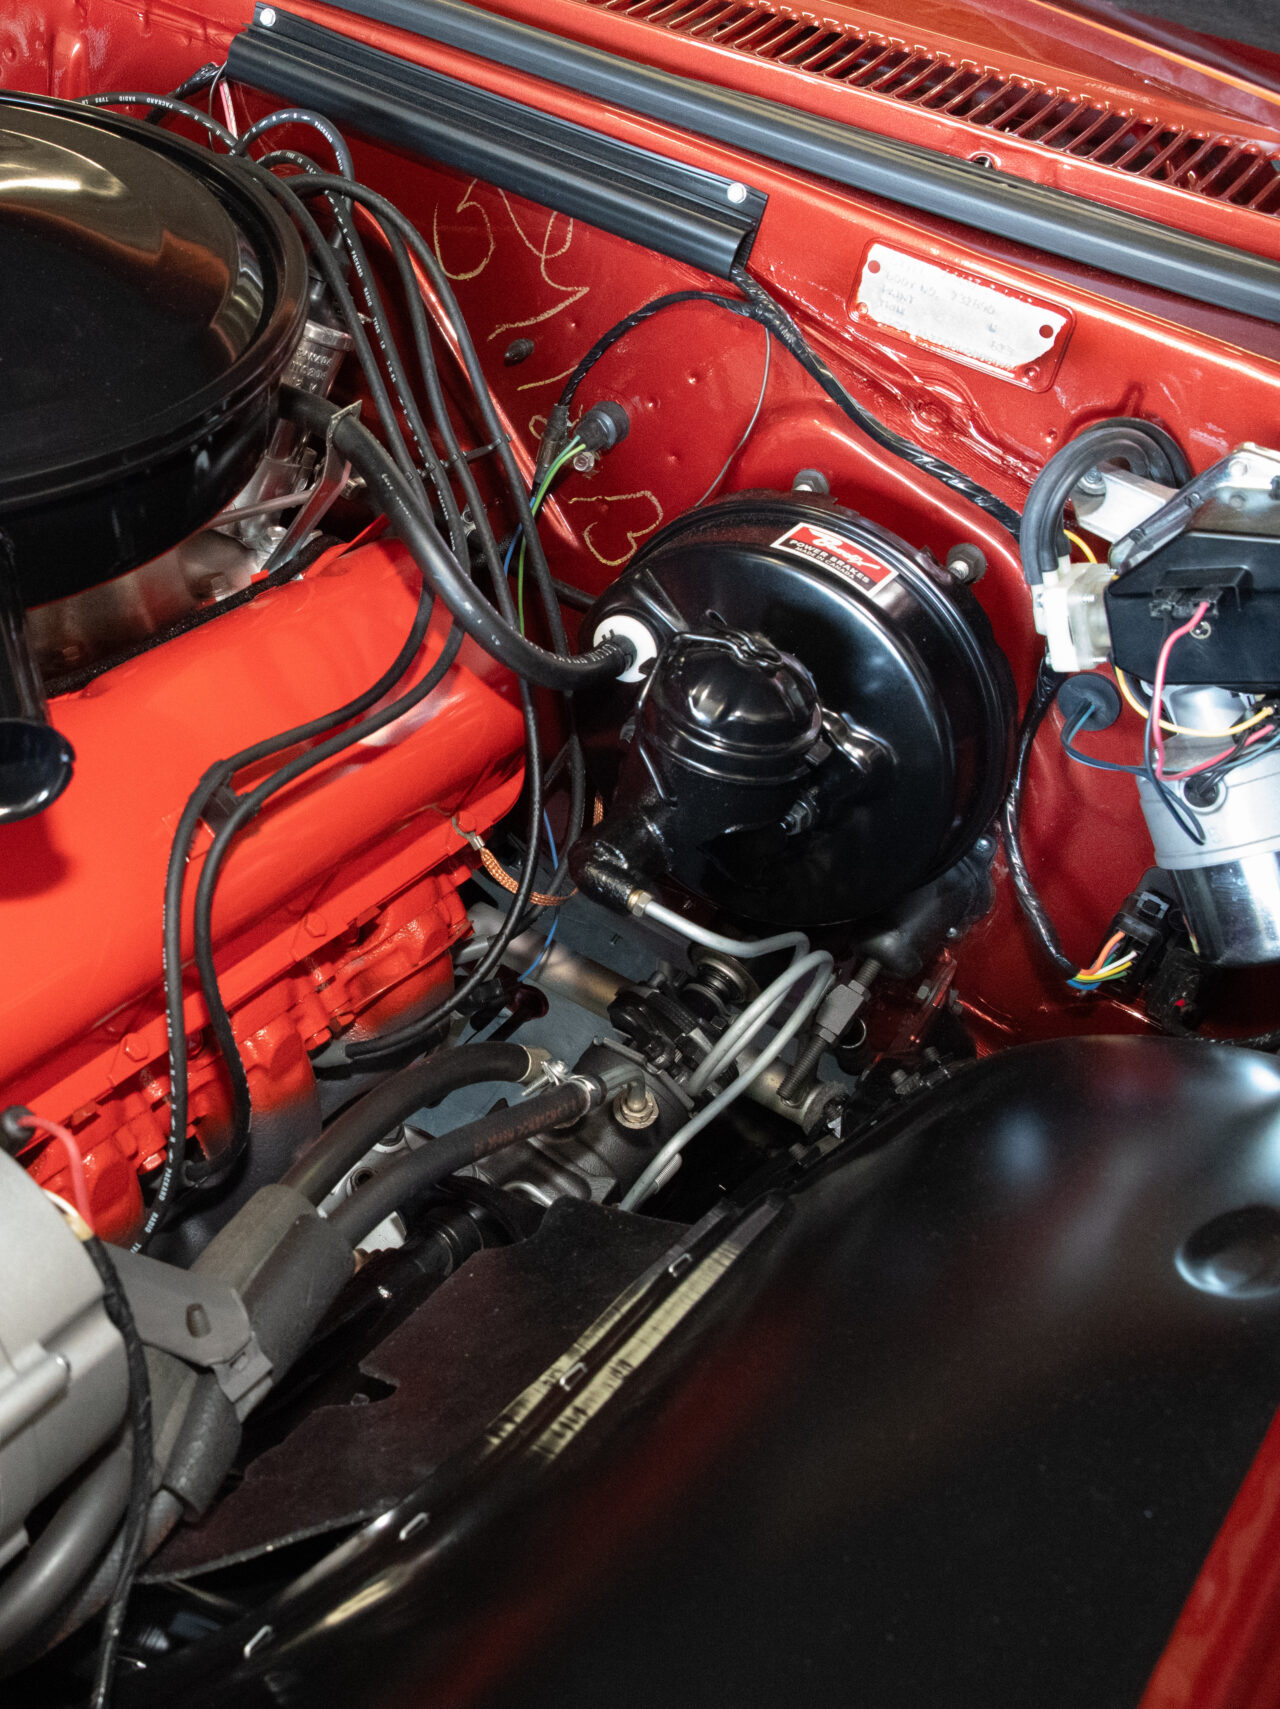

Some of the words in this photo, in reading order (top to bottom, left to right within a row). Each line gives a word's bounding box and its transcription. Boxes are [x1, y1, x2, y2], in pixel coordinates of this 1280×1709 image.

[146, 97, 173, 109] PACKARD
[313, 121, 333, 144] PACKARD
[350, 249, 364, 278] PACKARD
[363, 287, 373, 307] RADIO
[789, 539, 829, 557] POWER
[830, 555, 871, 583] BRAKES
[795, 547, 815, 558] MADE
[825, 560, 855, 579] CANADA
[159, 1168, 172, 1202] PACKARD
[144, 1211, 159, 1235] RADIO
